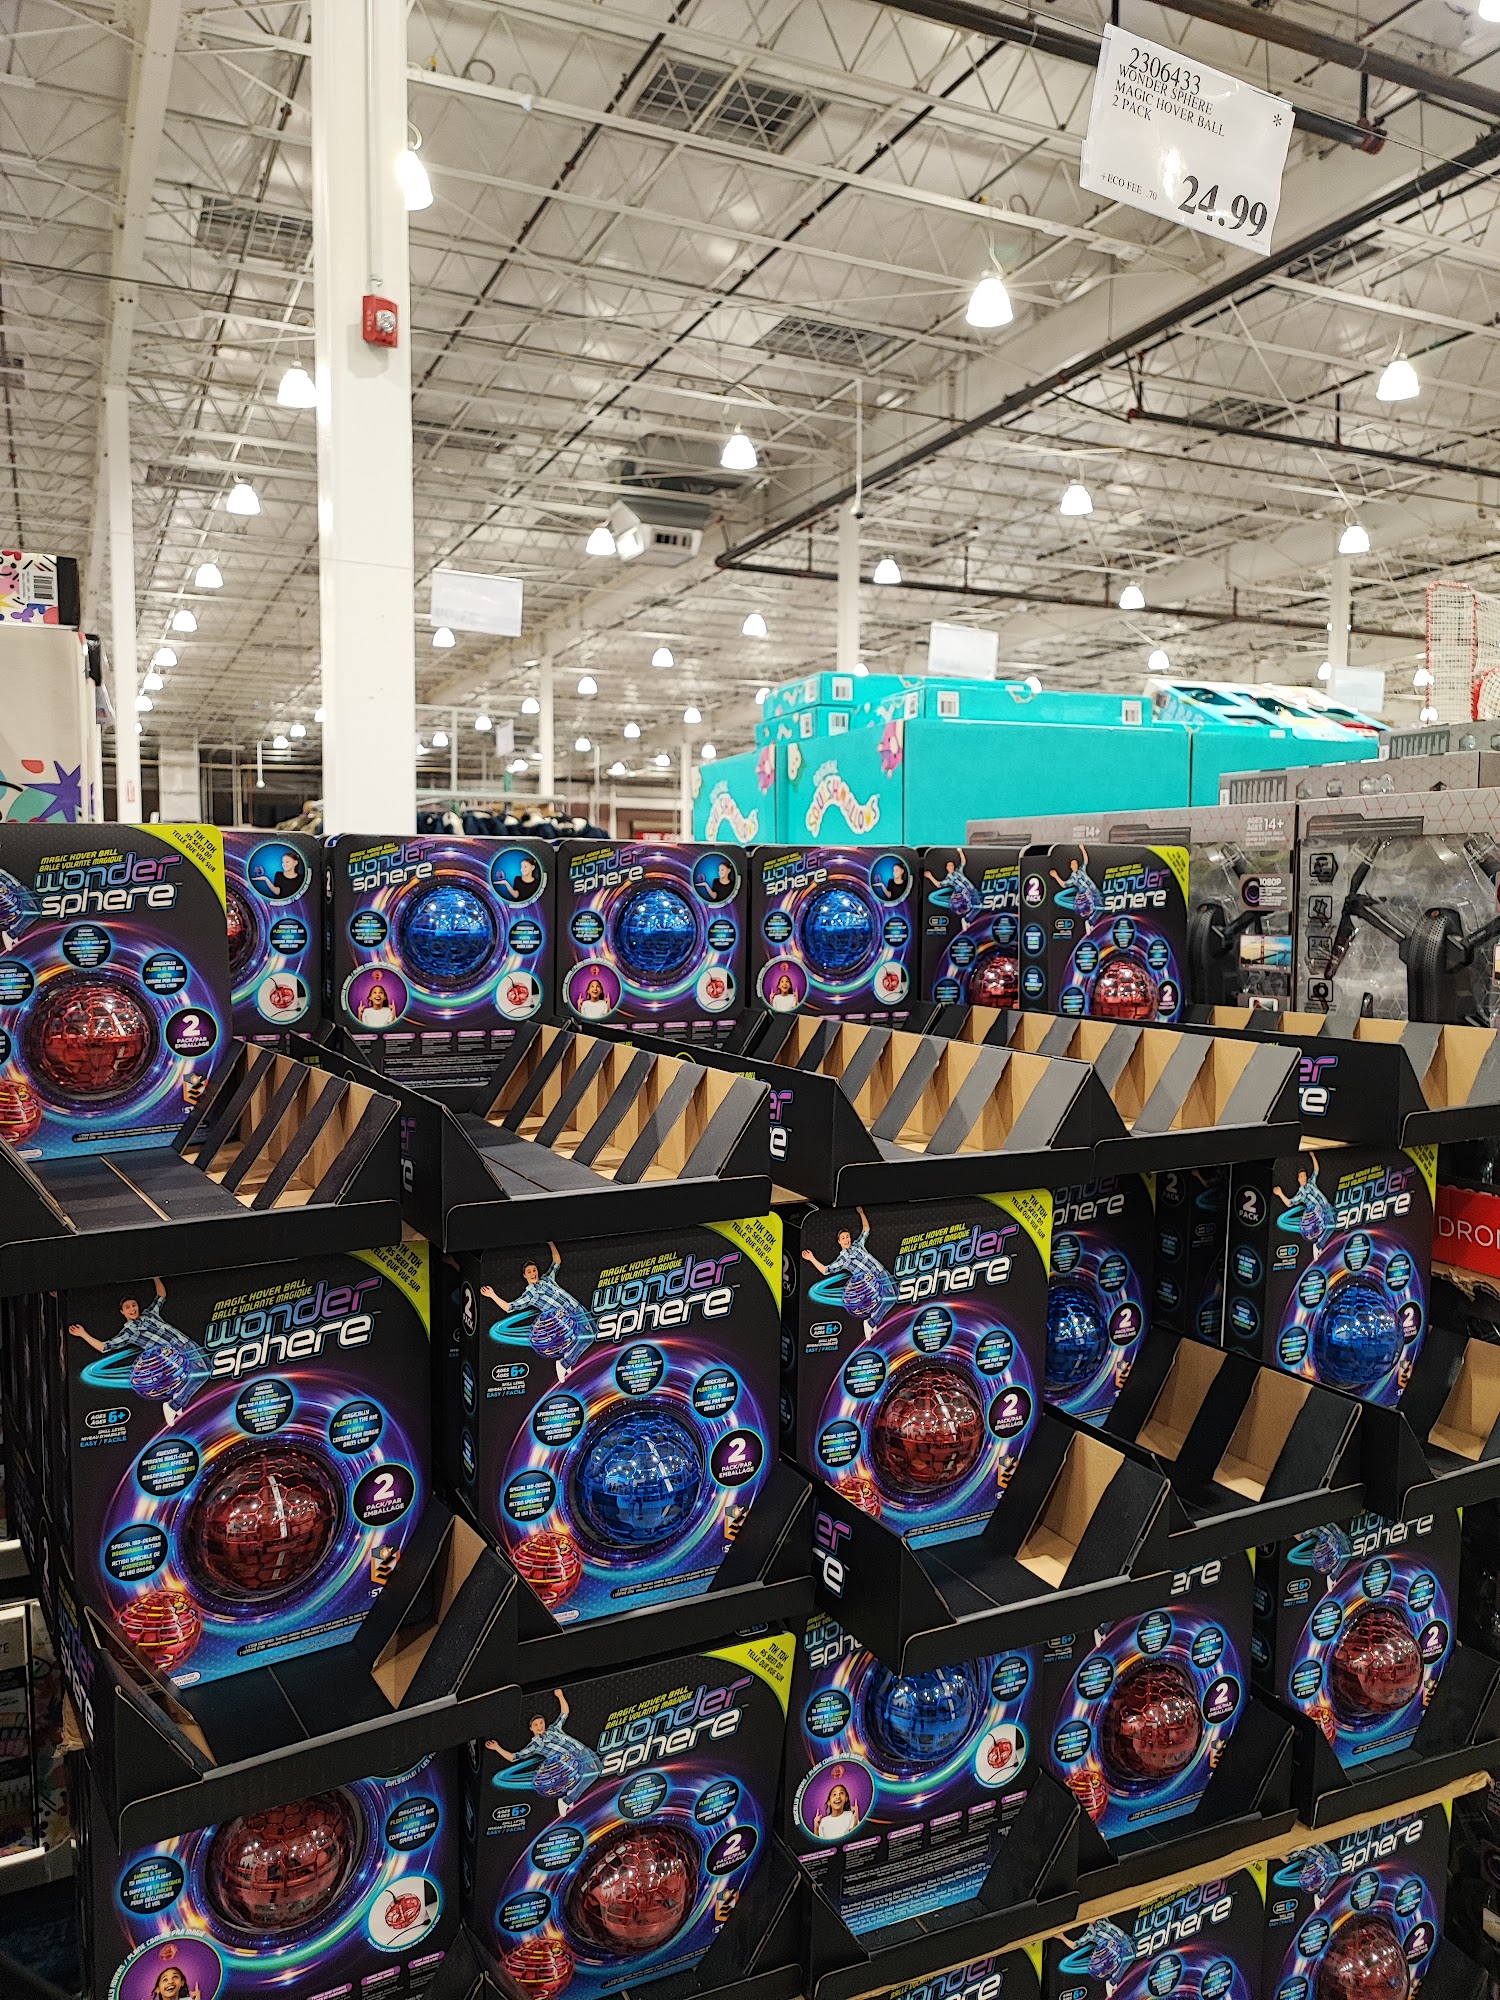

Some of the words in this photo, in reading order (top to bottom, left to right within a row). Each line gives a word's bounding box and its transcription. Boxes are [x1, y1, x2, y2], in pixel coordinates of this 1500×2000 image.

[1128, 48, 1201, 95] 2306433
[1119, 64, 1167, 96] WONDER
[1171, 89, 1213, 115] SPHERE
[1112, 95, 1119, 107] 2
[1122, 99, 1152, 121] PACK
[1115, 80, 1154, 105] MAGIC
[1156, 99, 1194, 124] HOVER
[1197, 116, 1224, 137] BALL
[1126, 181, 1142, 195] FEE
[1178, 175, 1268, 237] 24.99
[1264, 818, 1284, 831] 14+
[171, 830, 187, 844] TELLE
[195, 852, 206, 864] VUE
[205, 861, 216, 873] SUR
[193, 830, 205, 841] TIK
[204, 840, 217, 853] TOK
[39, 862, 60, 872] BALLE
[61, 860, 91, 870] VOLANTE
[92, 855, 123, 865] MAGIQUE
[41, 854, 67, 865] MAGIC
[70, 851, 97, 861] HOVER
[98, 848, 118, 858] BALL
[349, 843, 436, 876] wonder
[570, 846, 646, 879] wonder
[762, 851, 829, 884] wonder
[35, 853, 181, 893] wonder
[353, 862, 433, 893] sphere
[573, 864, 644, 894] sphere
[766, 868, 828, 896] sphere
[1103, 866, 1171, 894] wonder
[1259, 878, 1282, 886] 1080P
[1027, 877, 1040, 895] 2
[41, 884, 175, 918] sphere
[1104, 889, 1167, 913] sphere
[1163, 986, 1172, 1001] 2
[182, 1015, 201, 1036] 2
[175, 1041, 209, 1049] EMBALLAGE
[176, 1036, 207, 1044] PACK/PAR
[1165, 1173, 1178, 1193] 2
[1335, 1166, 1416, 1209] wonder
[1029, 1195, 1038, 1207] TIK
[1038, 1205, 1048, 1219] TOK
[1162, 1192, 1180, 1202] PACK
[1242, 1191, 1257, 1213] 2
[1011, 1197, 1023, 1212] TELLE
[1022, 1210, 1031, 1222] QUE
[1030, 1220, 1038, 1231] VUE
[1037, 1229, 1046, 1240] SUR
[1239, 1210, 1259, 1222] PACK
[1336, 1193, 1411, 1230] sphere
[744, 1224, 752, 1234] AS
[752, 1231, 765, 1246] SEEN
[764, 1244, 772, 1253] ON
[753, 1219, 764, 1233] TIK
[763, 1230, 777, 1245] TOK
[900, 1243, 918, 1254] BALLE
[919, 1236, 943, 1249] VOLANTE
[944, 1229, 970, 1243] MAGIQUE
[901, 1233, 924, 1246] MAGIC
[925, 1227, 949, 1240] HOVER
[950, 1223, 966, 1233] BALL
[731, 1222, 746, 1239] TELLE
[745, 1236, 756, 1249] QUE
[755, 1246, 765, 1259] VUE
[763, 1256, 774, 1268] SUR
[896, 1226, 1017, 1276] wonder
[1287, 1246, 1297, 1255] 6+
[385, 1246, 395, 1256] AS
[393, 1253, 409, 1270] SEEN
[408, 1267, 418, 1277] ON
[407, 1252, 424, 1269] TOK
[600, 1265, 627, 1279] MAGIC
[629, 1258, 656, 1271] HOVER
[658, 1251, 677, 1263] BALL
[386, 1258, 399, 1272] QUE
[398, 1269, 411, 1282] VUE
[408, 1279, 421, 1293] SUR
[593, 1254, 739, 1312] wonder
[597, 1276, 619, 1288] BALLE
[621, 1267, 649, 1282] VOLANTE
[651, 1259, 683, 1273] MAGIQUE
[898, 1257, 1010, 1302] sphere
[211, 1308, 237, 1321] BALLE
[239, 1298, 274, 1313] VOLANTE
[275, 1286, 313, 1304] MAGIQUE
[214, 1295, 247, 1311] MAGIC
[249, 1286, 282, 1301] HOVER
[283, 1279, 307, 1293] BALL
[464, 1288, 473, 1319] 2
[206, 1279, 380, 1347] wonder
[596, 1288, 731, 1340] sphere
[1119, 1308, 1132, 1328] 2
[1404, 1307, 1414, 1326] 2
[826, 1323, 839, 1335] 6+
[211, 1315, 372, 1376] sphere
[511, 1366, 525, 1377] 6+
[108, 1411, 126, 1423] 6+
[1002, 1394, 1018, 1417] 2
[994, 1419, 1024, 1431] EMBALLAGE
[996, 1414, 1023, 1425] PACK/PAR
[104, 1436, 127, 1444] FACILE
[728, 1438, 746, 1463] 2
[719, 1466, 754, 1478] EMBALLAGE
[721, 1461, 752, 1472] PACK/PAR
[373, 1472, 394, 1501] 2
[363, 1503, 405, 1518] EMBALLAGE
[366, 1498, 402, 1511] PACK/PAR
[1352, 1514, 1433, 1556] sphere
[1299, 1580, 1308, 1589] 6+
[1428, 1626, 1439, 1646] 2
[760, 1649, 768, 1657] AS
[765, 1653, 778, 1667] SEEN
[776, 1662, 784, 1670] ON
[768, 1642, 780, 1654] TIK
[778, 1650, 789, 1662] TOK
[746, 1649, 760, 1664] TELLE
[758, 1660, 768, 1671] QUE
[767, 1666, 777, 1677] VUE
[774, 1672, 785, 1683] SUR
[608, 1704, 637, 1722] MAGIC
[638, 1694, 666, 1709] HOVER
[667, 1685, 689, 1700] BALL
[1215, 1682, 1228, 1704] 2
[599, 1677, 752, 1751] wonder
[605, 1716, 627, 1730] BALLE
[629, 1704, 659, 1721] VOLANTE
[660, 1691, 693, 1709] MAGIQUE
[1208, 1706, 1234, 1718] EMBALLAGE
[601, 1709, 740, 1774] sphere
[420, 1759, 430, 1769] LES
[398, 1804, 426, 1817] MAGICALLY
[512, 1807, 526, 1817] 6+
[723, 1834, 743, 1857] 2
[1341, 1819, 1423, 1873] sphere
[713, 1853, 749, 1872] EMBALLAGE
[1286, 1902, 1295, 1911] 6+
[1136, 1896, 1232, 1957] sphere
[1413, 1928, 1425, 1946] 2
